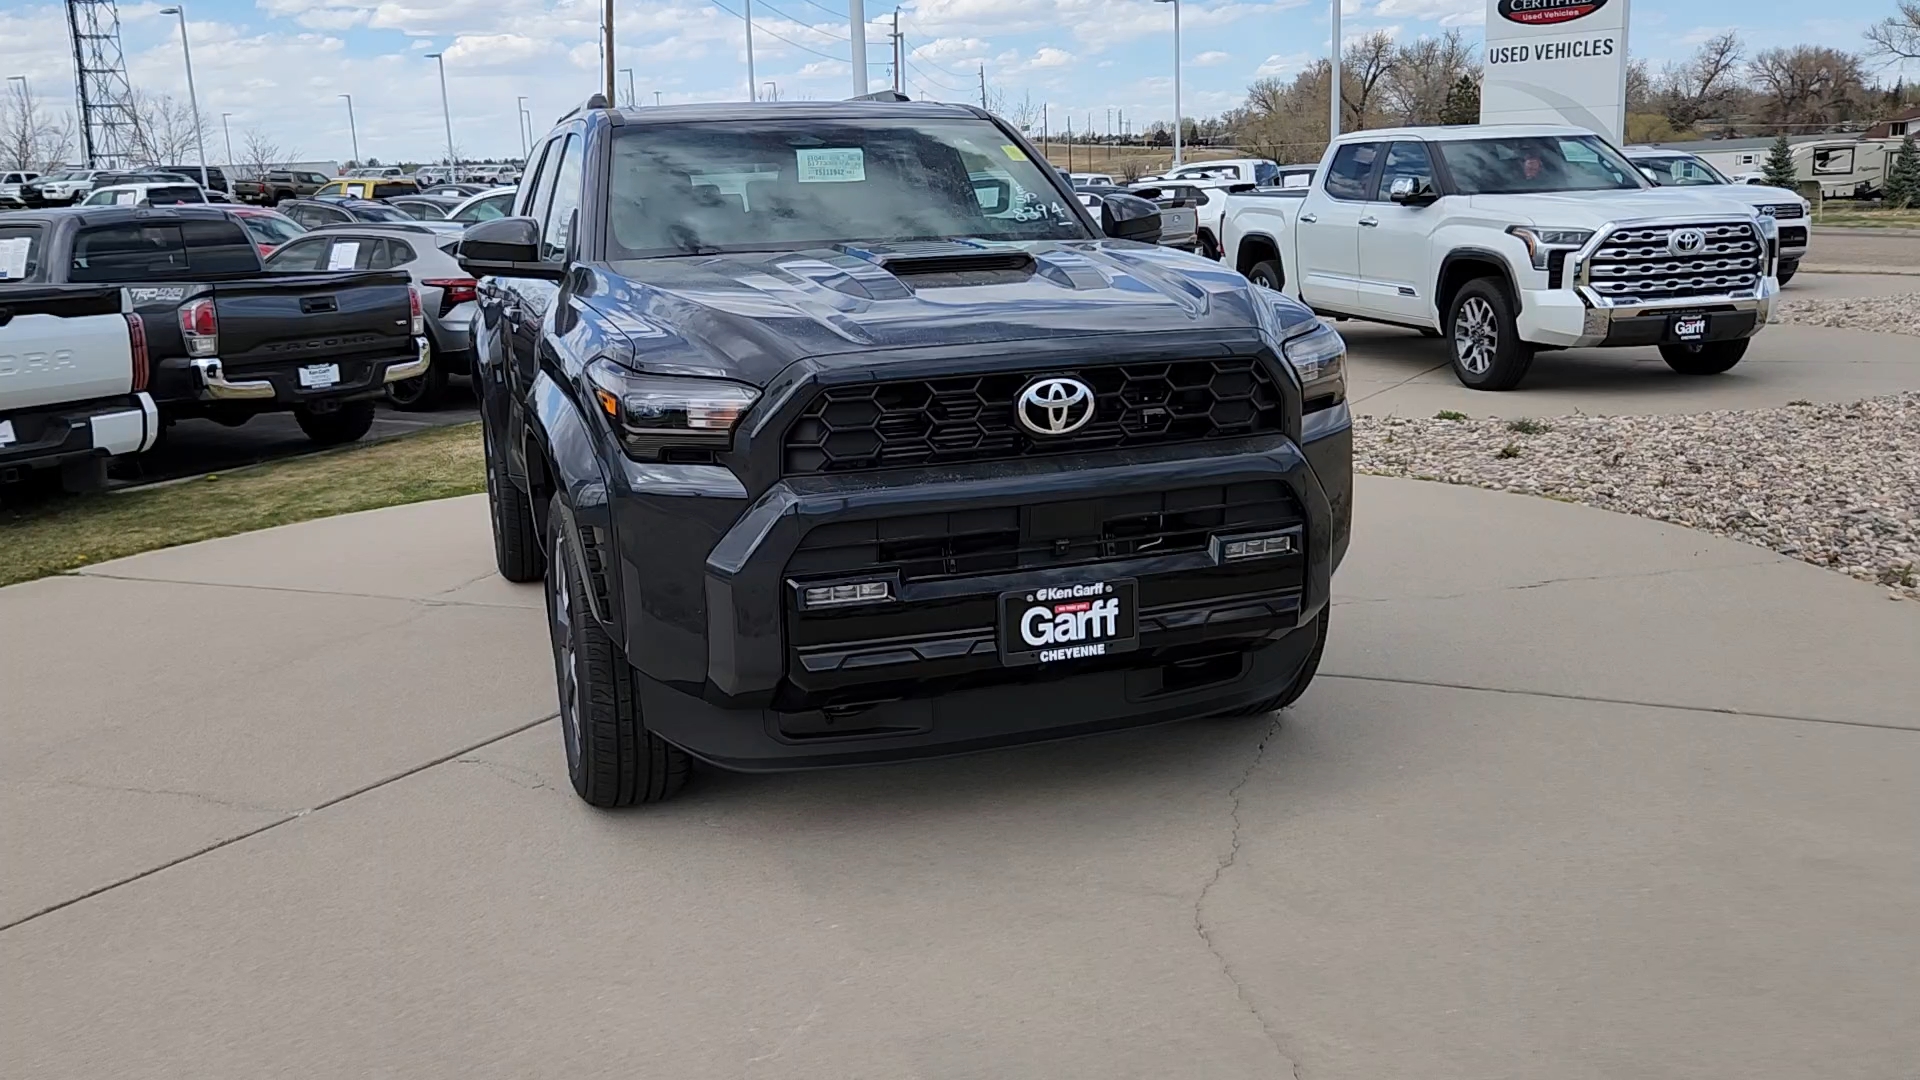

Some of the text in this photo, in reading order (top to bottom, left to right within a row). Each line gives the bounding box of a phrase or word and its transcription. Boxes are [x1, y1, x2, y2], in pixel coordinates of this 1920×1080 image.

[1510, 0, 1592, 11] CERTIF
[1522, 9, 1579, 21] Used Vehicles
[1489, 38, 1614, 64] USED VEHICLES
[1012, 201, 1065, 222] 8394
[131, 287, 158, 300] TRD
[1674, 320, 1705, 335] Garff
[265, 335, 376, 352] TACOMA
[1048, 582, 1104, 600] Ken Garff
[1021, 598, 1119, 646] Garff
[1040, 643, 1105, 662] CHEYENNE
